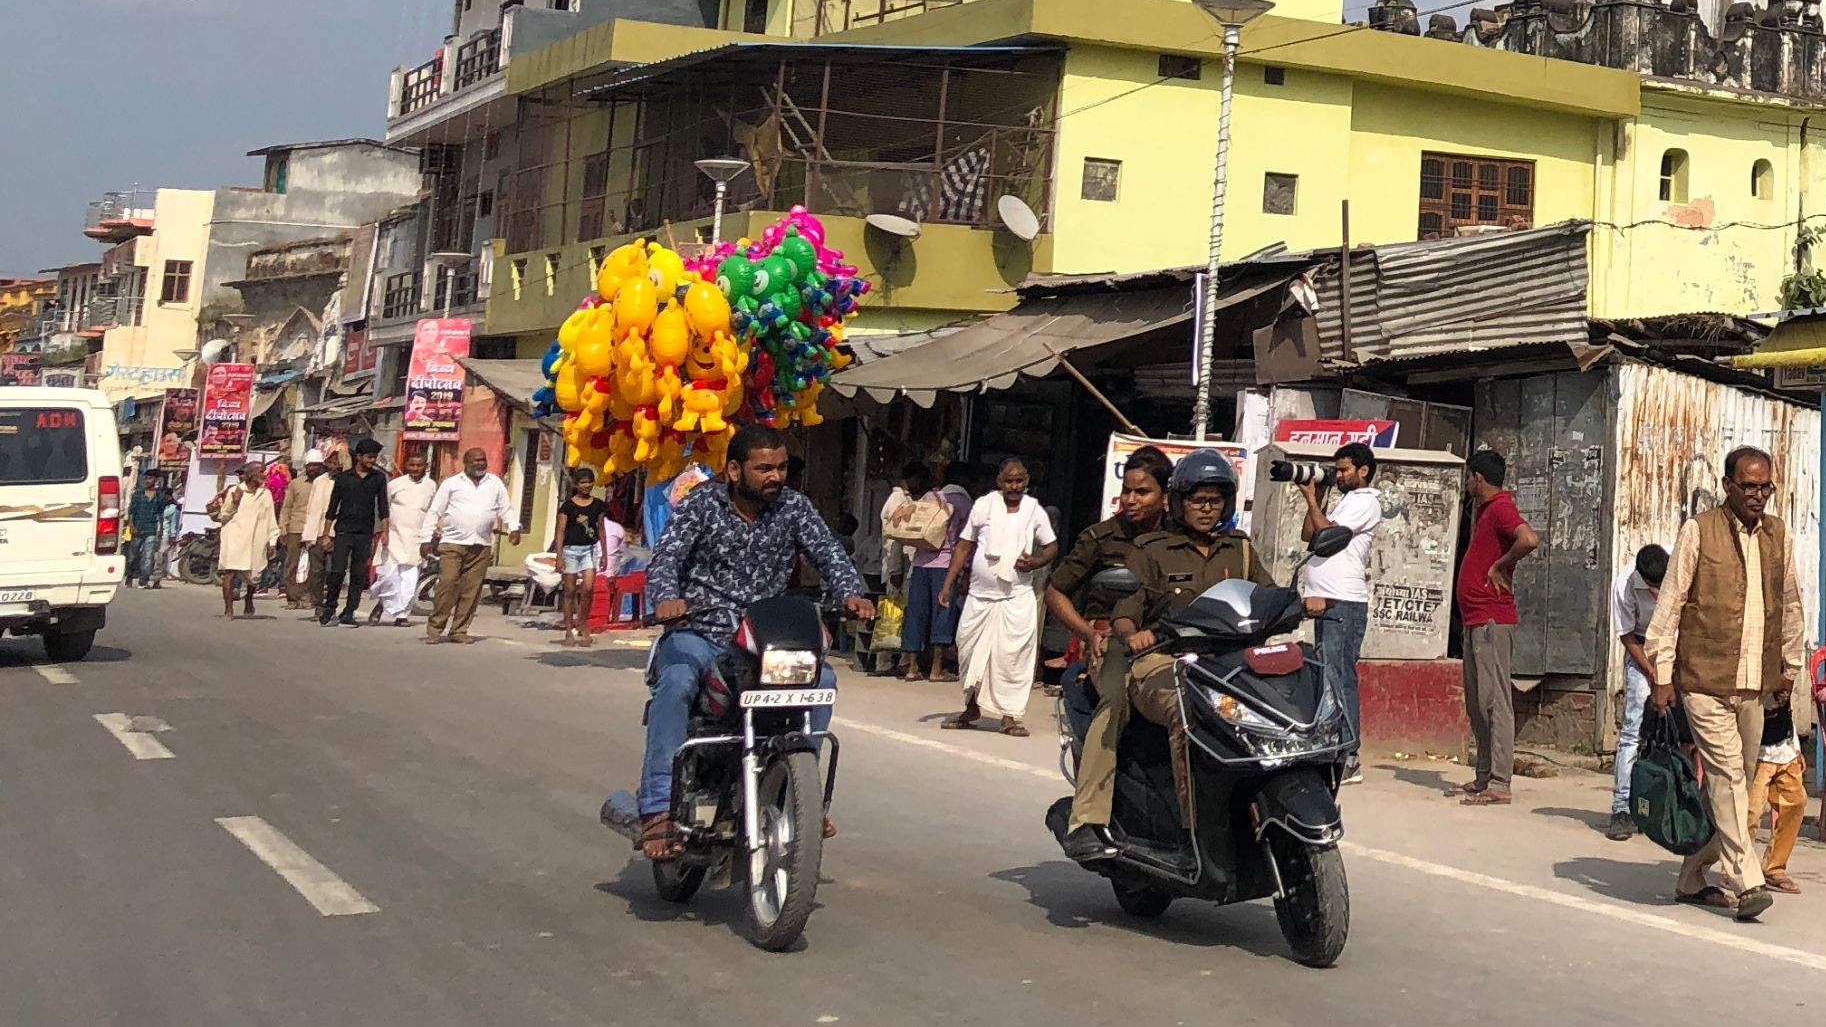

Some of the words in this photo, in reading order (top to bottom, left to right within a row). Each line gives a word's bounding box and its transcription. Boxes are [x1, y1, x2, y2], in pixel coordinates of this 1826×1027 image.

[430, 391, 454, 401] 2019
[1372, 608, 1393, 620] SSC
[1395, 610, 1433, 624] RAILWA
[785, 693, 795, 704] X
